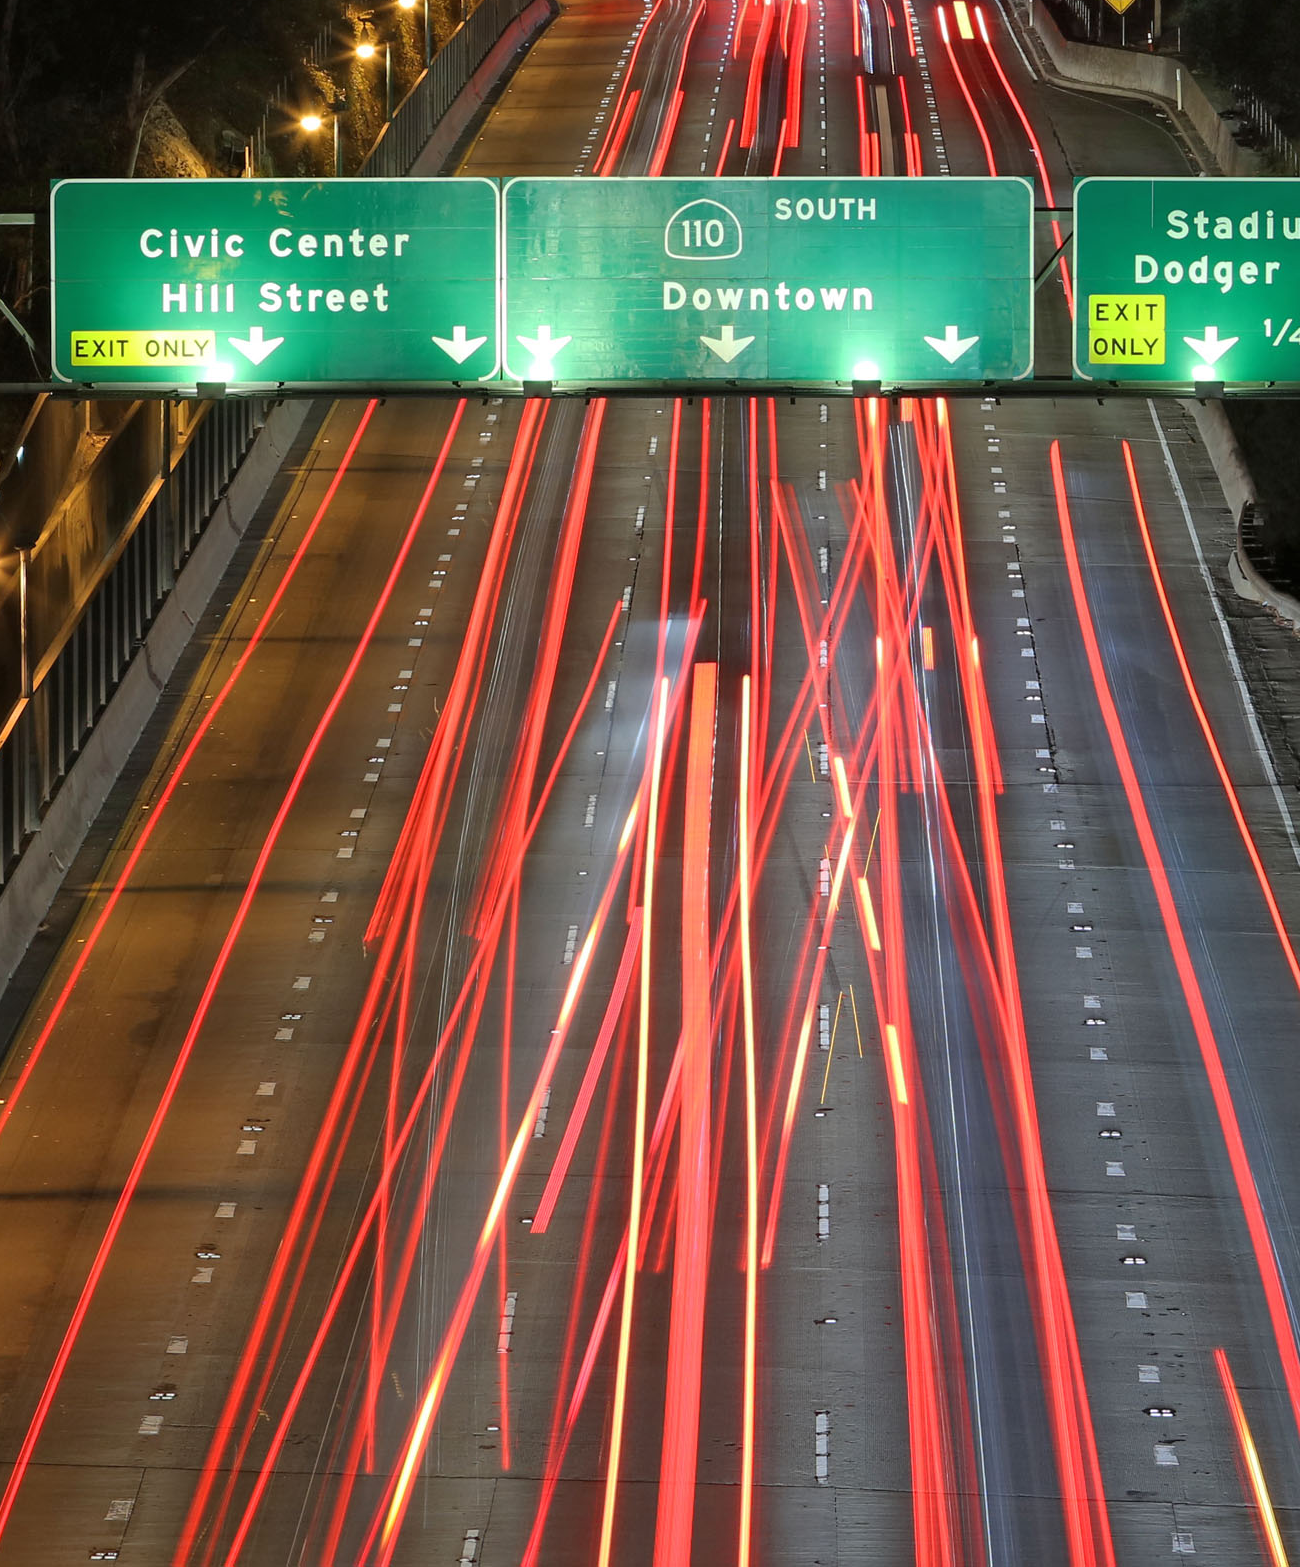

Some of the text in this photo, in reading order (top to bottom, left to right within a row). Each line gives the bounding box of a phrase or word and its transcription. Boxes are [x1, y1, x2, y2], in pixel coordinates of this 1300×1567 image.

[774, 198, 877, 221] SOUTH
[140, 228, 410, 258] Civic Center
[682, 219, 725, 247] 110
[1134, 254, 1281, 294] Dodger
[162, 282, 390, 313] Hill Street
[663, 281, 874, 311] Downtown
[1095, 303, 1159, 321] EXIT
[75, 339, 210, 358] EXIT ONLY
[1093, 337, 1159, 356] ONLY
